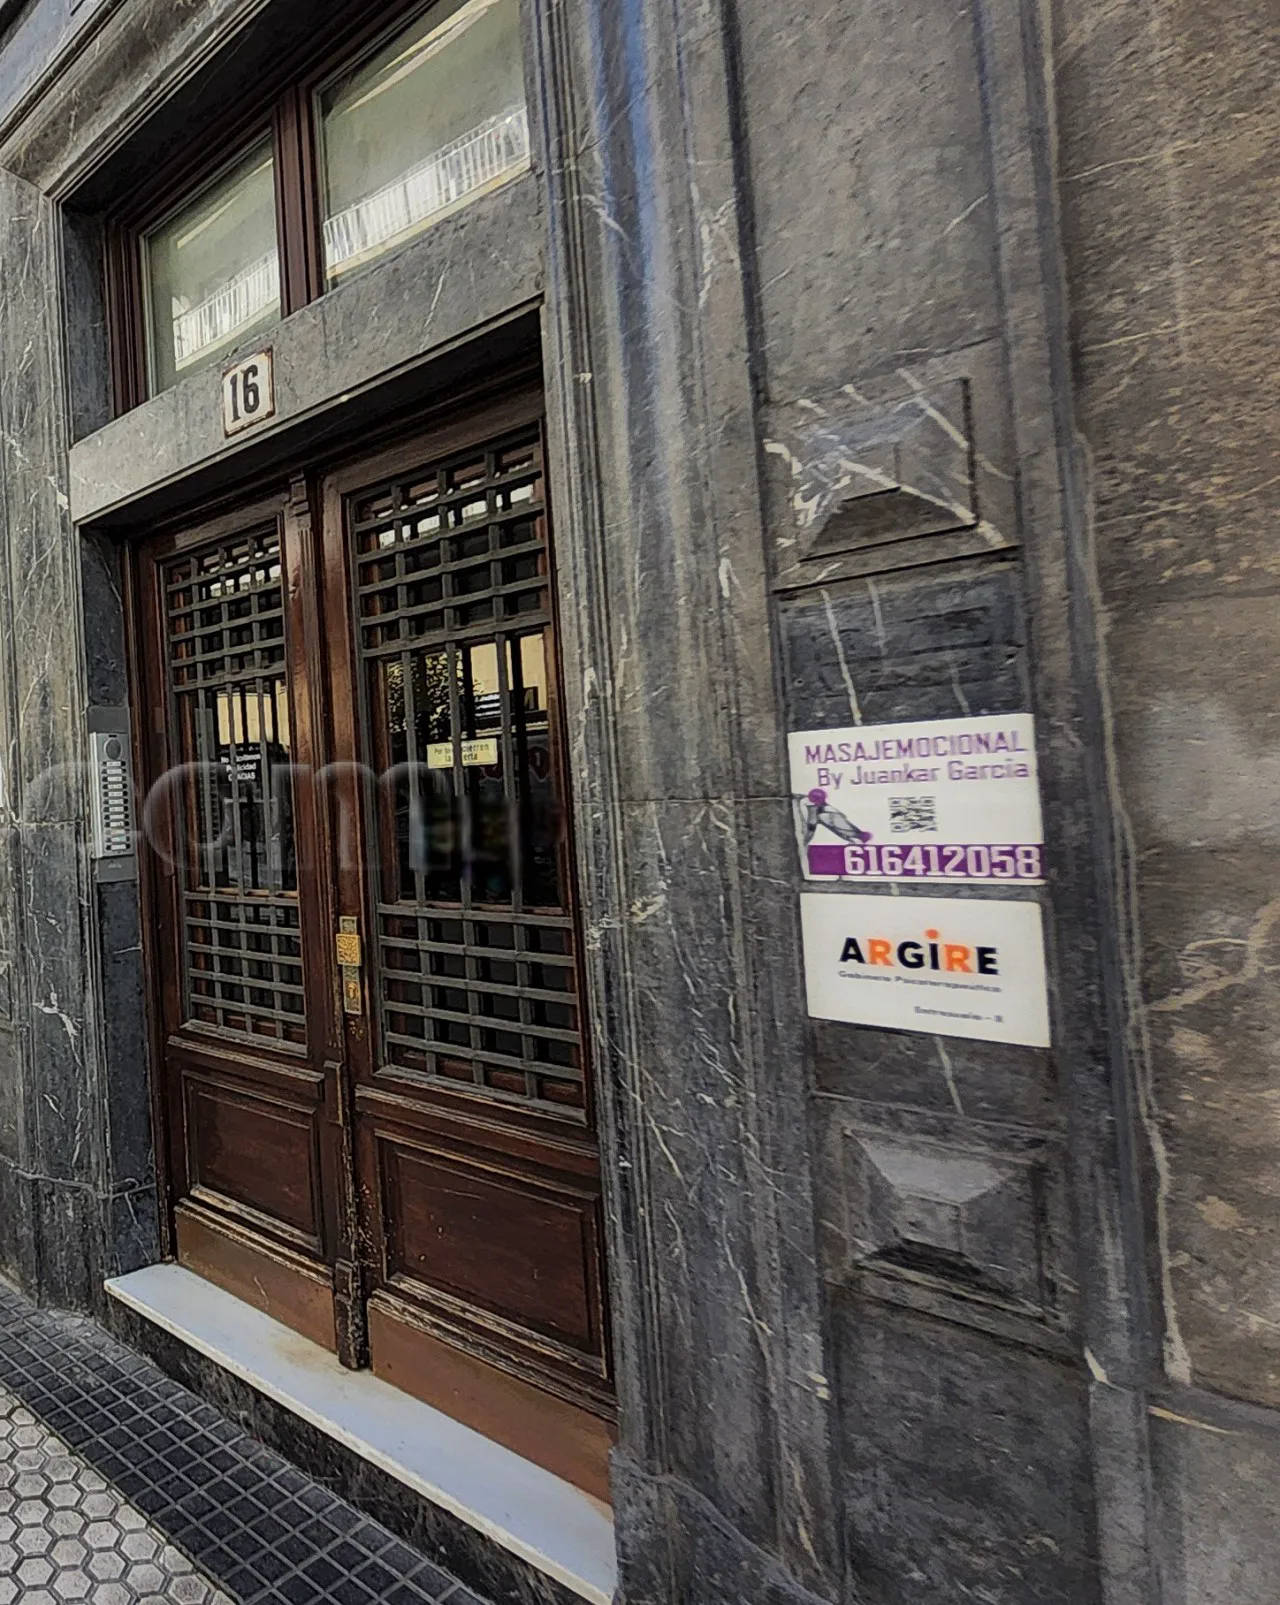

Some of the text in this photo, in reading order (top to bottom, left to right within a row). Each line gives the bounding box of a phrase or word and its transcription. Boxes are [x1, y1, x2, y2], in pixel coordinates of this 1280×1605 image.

[230, 364, 260, 423] 16
[805, 731, 1028, 764] MASAJEMOCIONAL
[228, 772, 255, 781] GACIAS
[817, 767, 844, 789] By
[850, 763, 941, 785] Juankar
[844, 845, 1041, 878] 616412058
